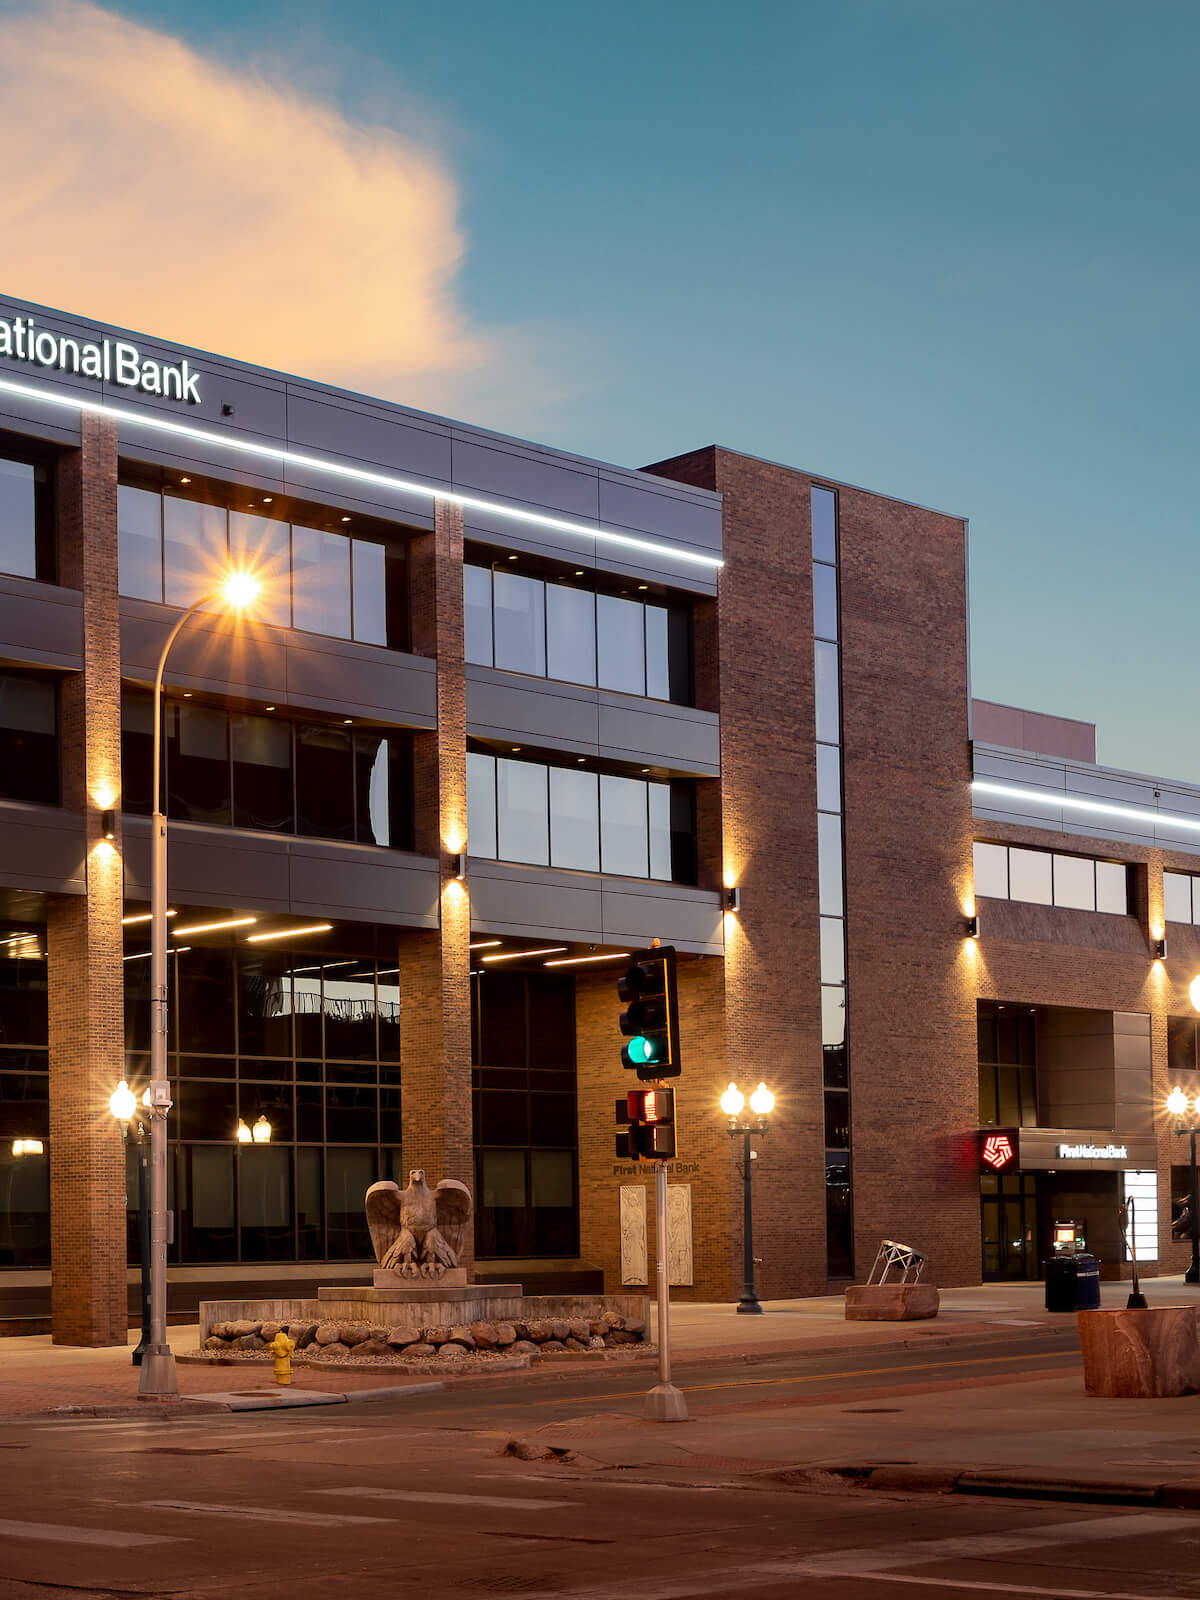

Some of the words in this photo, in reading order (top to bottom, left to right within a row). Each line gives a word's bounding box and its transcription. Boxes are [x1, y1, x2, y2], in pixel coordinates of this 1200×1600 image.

[115, 341, 202, 404] Bank
[613, 1165, 637, 1176] First
[676, 1161, 700, 1173] Bank
